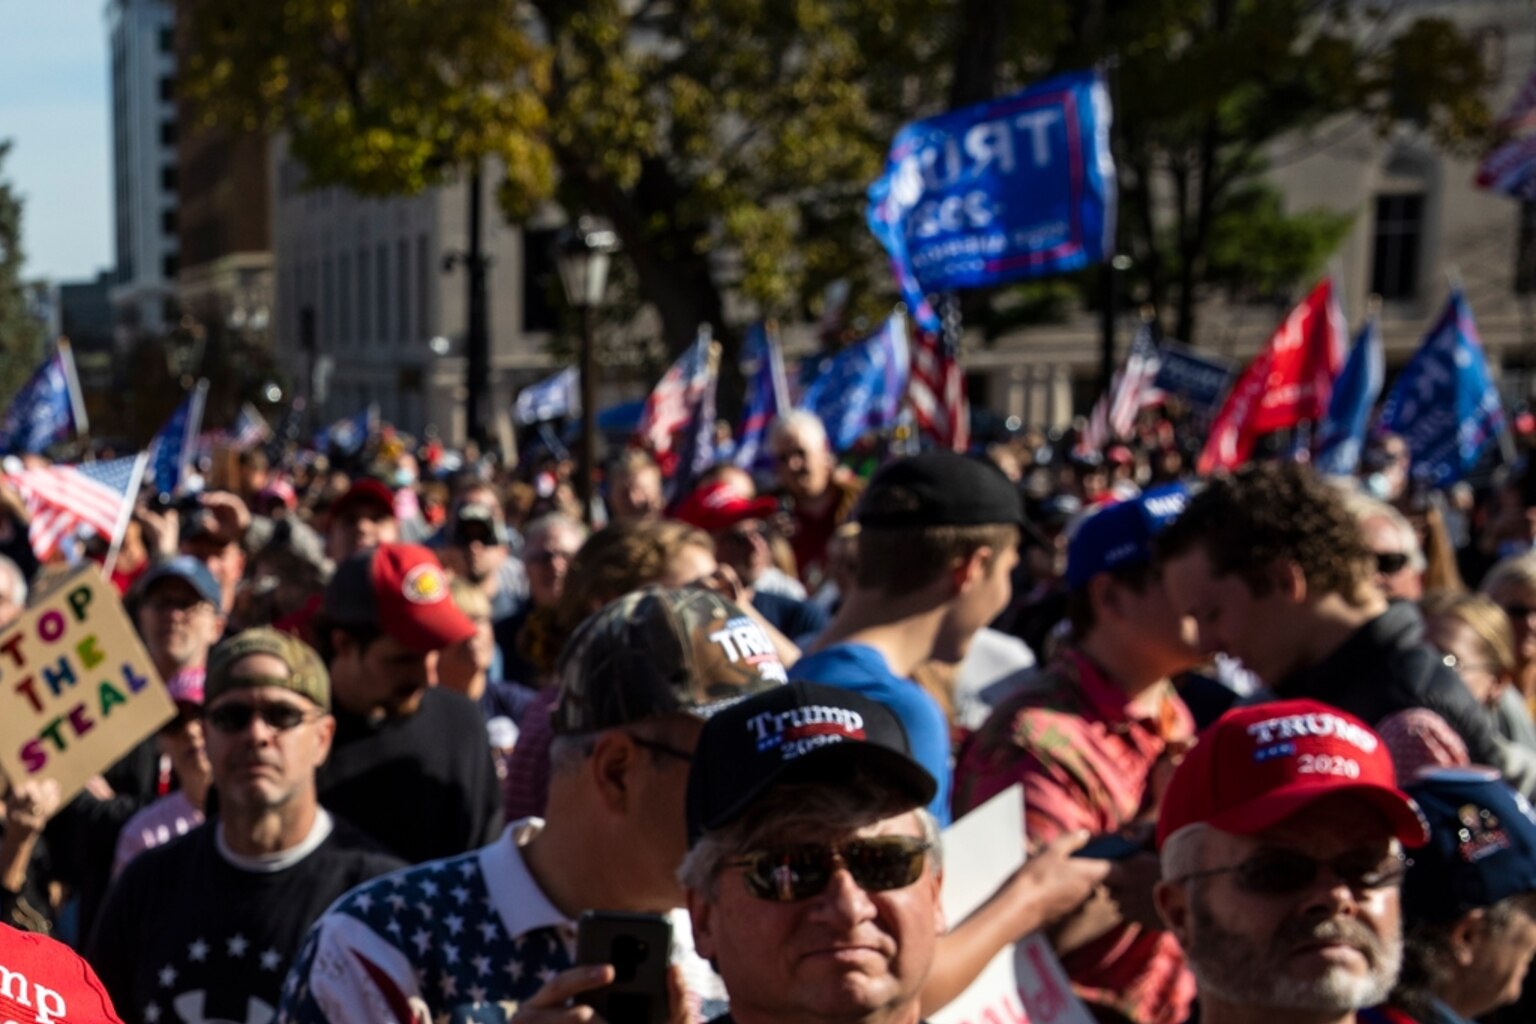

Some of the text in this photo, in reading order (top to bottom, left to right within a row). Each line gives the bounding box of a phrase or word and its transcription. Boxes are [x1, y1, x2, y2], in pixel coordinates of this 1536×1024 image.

[15, 634, 106, 713] THE
[19, 664, 148, 775] STEAL
[746, 705, 864, 741] Trump
[1246, 712, 1378, 755] TRUMP
[1296, 753, 1360, 780] 2020
